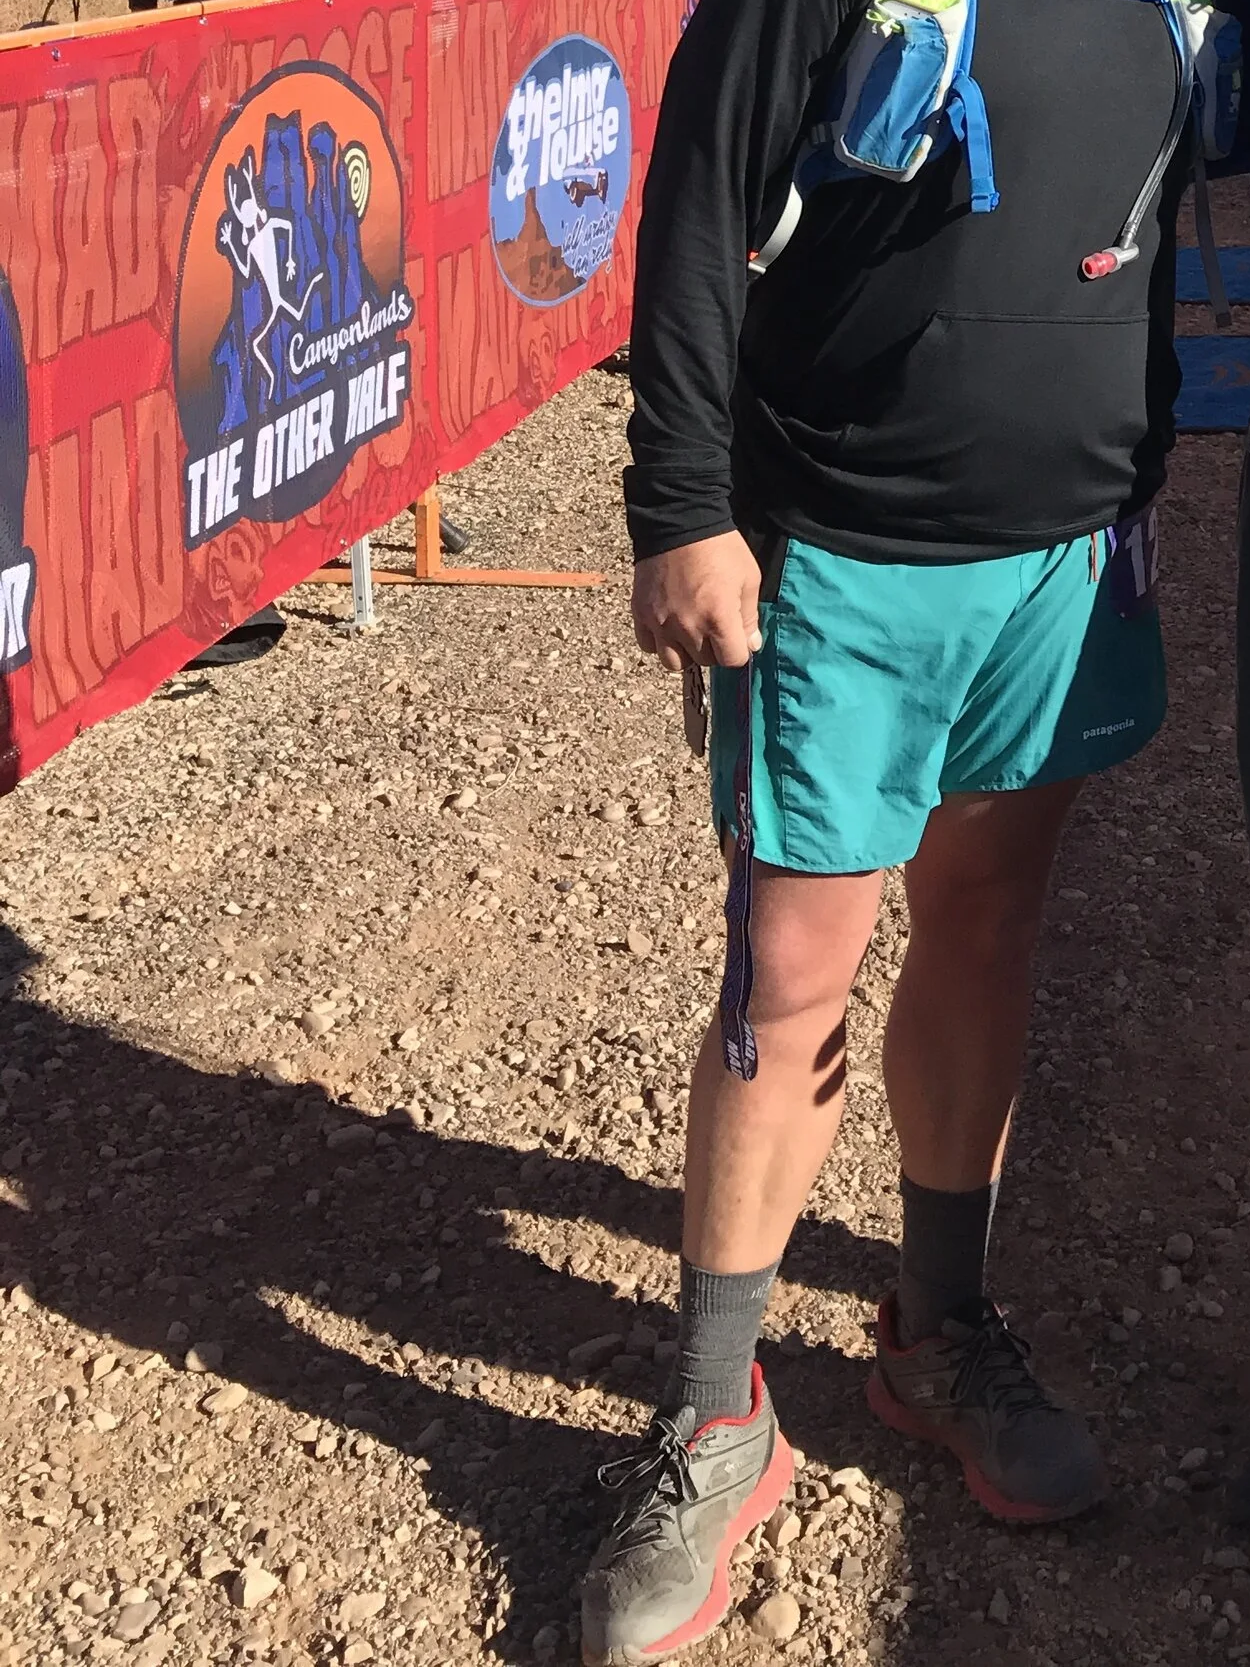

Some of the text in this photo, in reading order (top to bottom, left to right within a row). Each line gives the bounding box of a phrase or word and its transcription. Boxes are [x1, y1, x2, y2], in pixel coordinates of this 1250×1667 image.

[508, 62, 612, 148] thelma
[539, 105, 619, 187] louise
[289, 289, 412, 375] Canyonlands
[187, 437, 245, 538] THE
[252, 388, 335, 500] OTHER
[344, 350, 407, 445] HALF
[1082, 718, 1136, 740] patagonia
